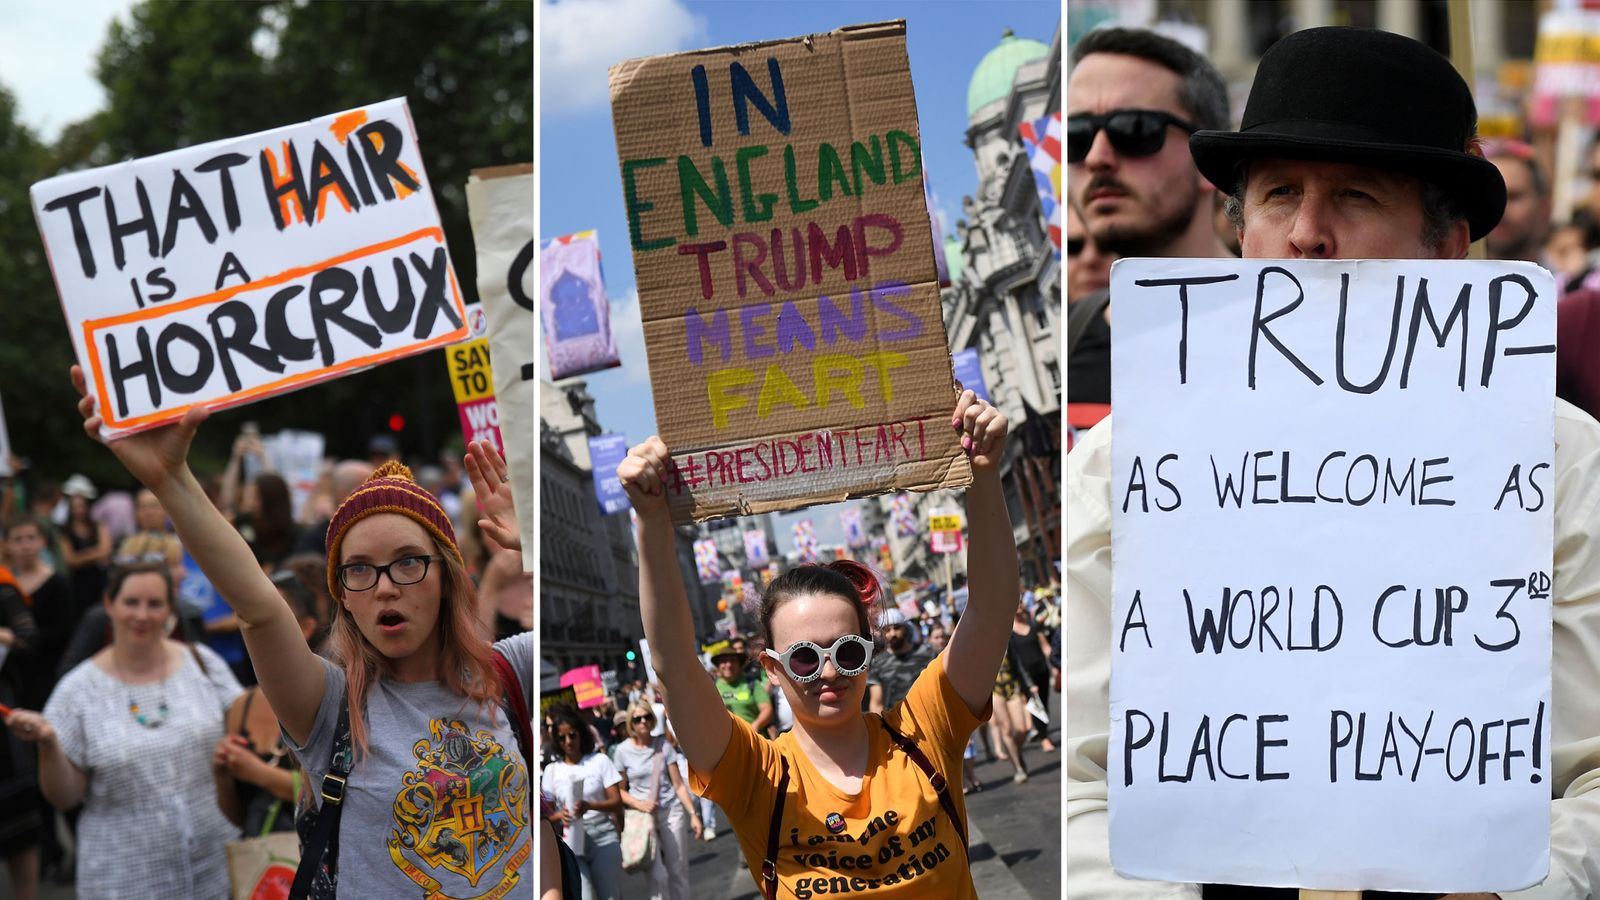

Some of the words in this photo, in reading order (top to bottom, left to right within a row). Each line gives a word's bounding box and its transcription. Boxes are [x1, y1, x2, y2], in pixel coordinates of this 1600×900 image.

[691, 57, 792, 147] IN
[43, 152, 252, 278] THAT
[260, 116, 421, 232] HAIR
[623, 129, 921, 251] ENGLAND
[131, 266, 177, 308] IS
[215, 251, 251, 291] A
[678, 213, 905, 300] TRUMP
[105, 246, 465, 419] HORCRUX
[684, 279, 925, 367] MEANS
[458, 371, 488, 396] TO
[706, 351, 911, 431] FART
[1122, 453, 1182, 513] AS
[1210, 451, 1456, 508] WELCOME
[1494, 462, 1550, 512] AS
[1120, 590, 1152, 652] A
[1183, 584, 1344, 654] WORLD
[1372, 585, 1468, 648] CUP
[1124, 709, 1290, 787] PLACE
[1330, 700, 1545, 785] PLAY-OFF!
[458, 801, 481, 831] H
[793, 850, 873, 870] voice
[878, 835, 906, 865] of
[908, 816, 936, 848] my
[403, 863, 431, 887] DRACO
[795, 842, 951, 900] generation
